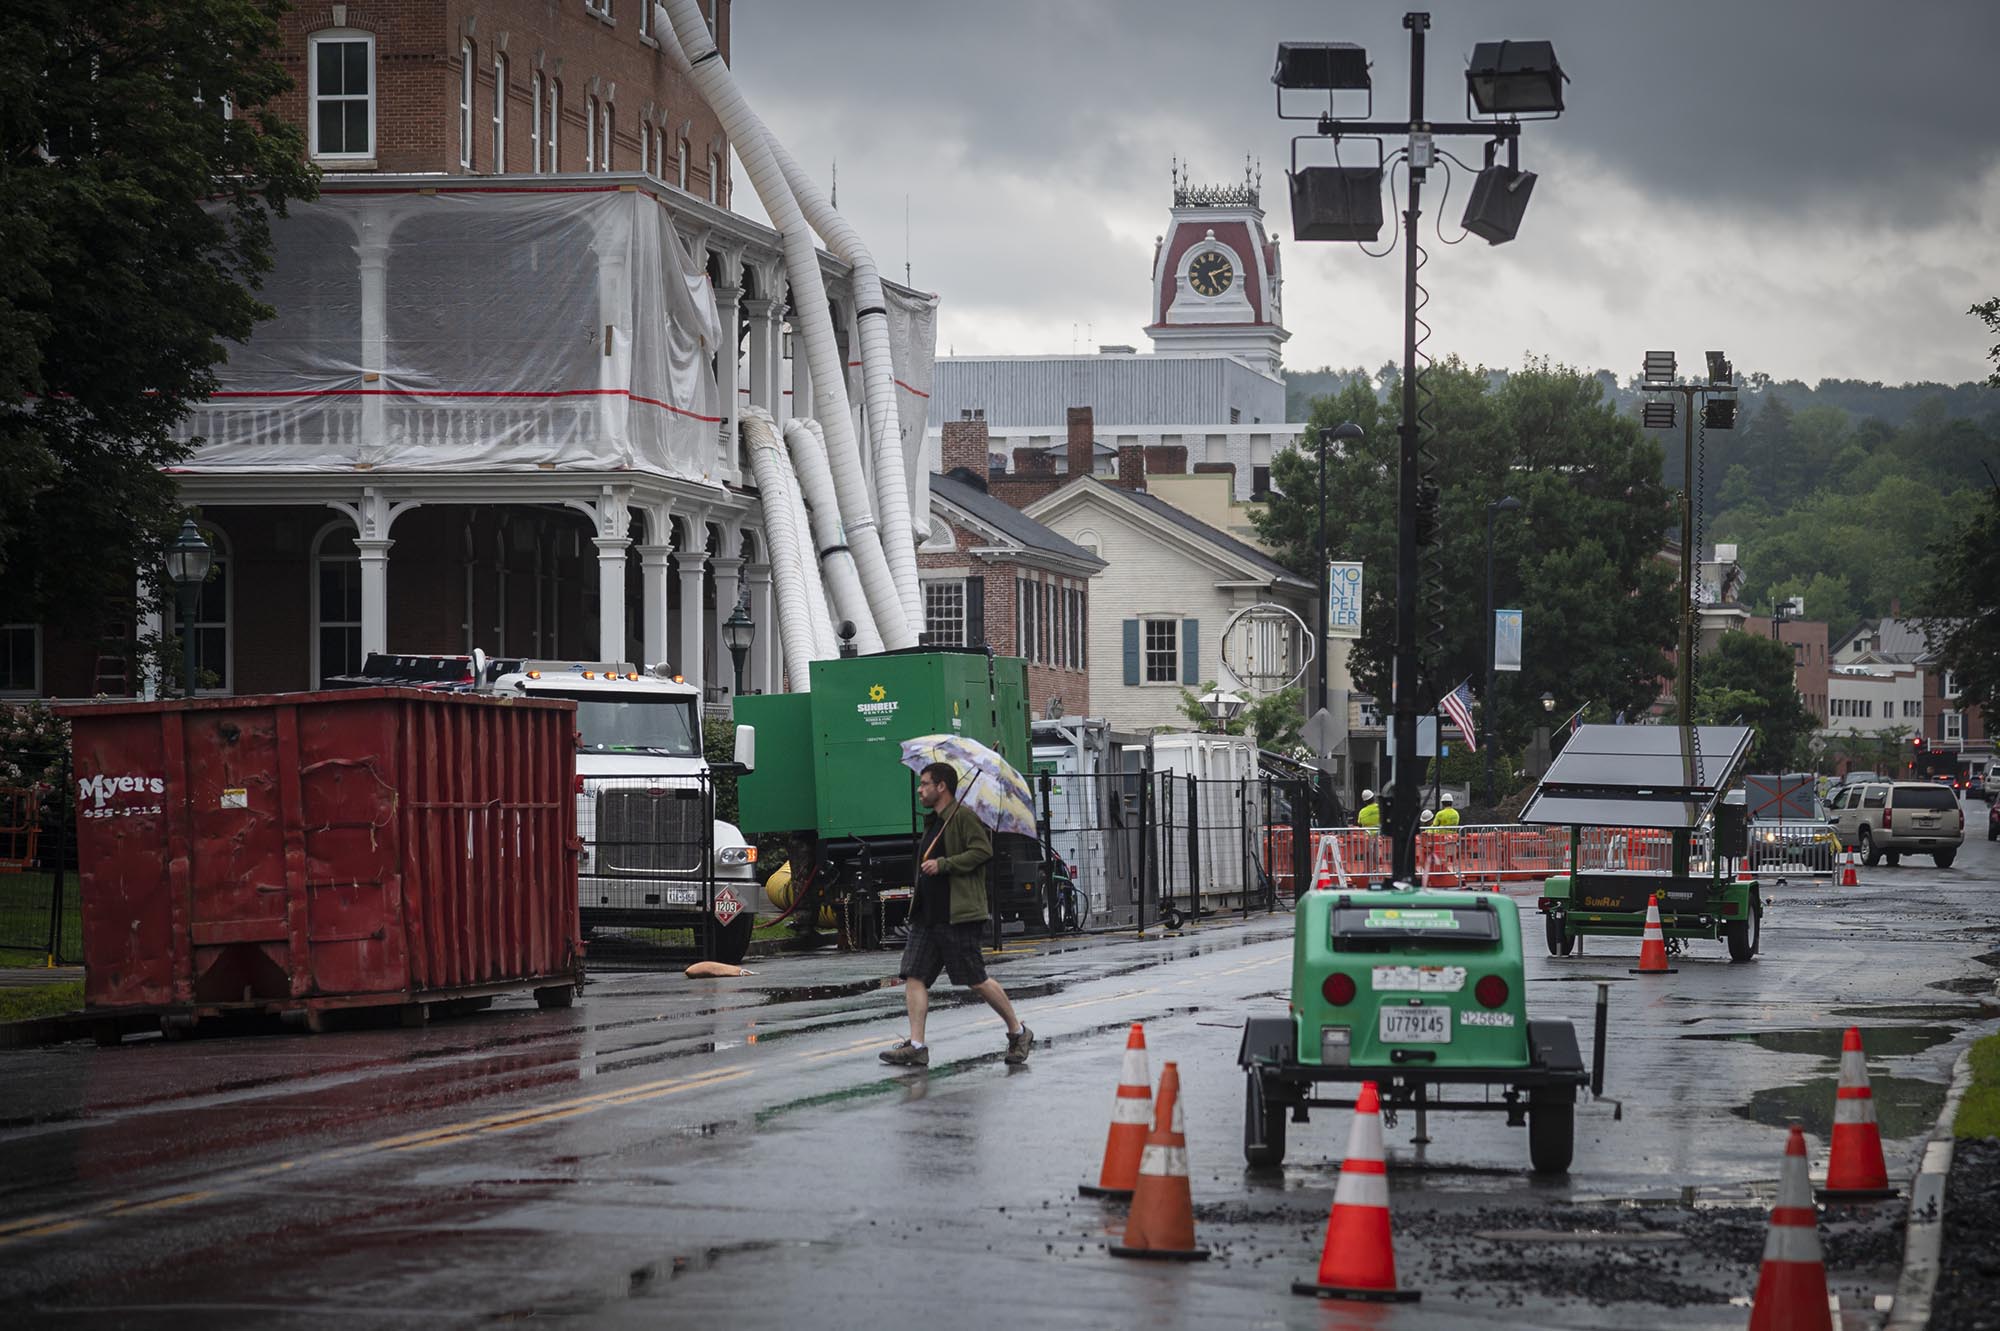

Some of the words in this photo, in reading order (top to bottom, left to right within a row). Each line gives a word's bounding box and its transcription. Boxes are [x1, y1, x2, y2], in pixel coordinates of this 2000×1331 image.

[1332, 567, 1360, 582] MO
[1331, 582, 1360, 596] NT
[1331, 596, 1359, 611] PEL
[1332, 611, 1359, 625] IER
[857, 701, 899, 712] SUNBELT
[717, 902, 736, 912] 1203
[1387, 1016, 1444, 1033] U779145
